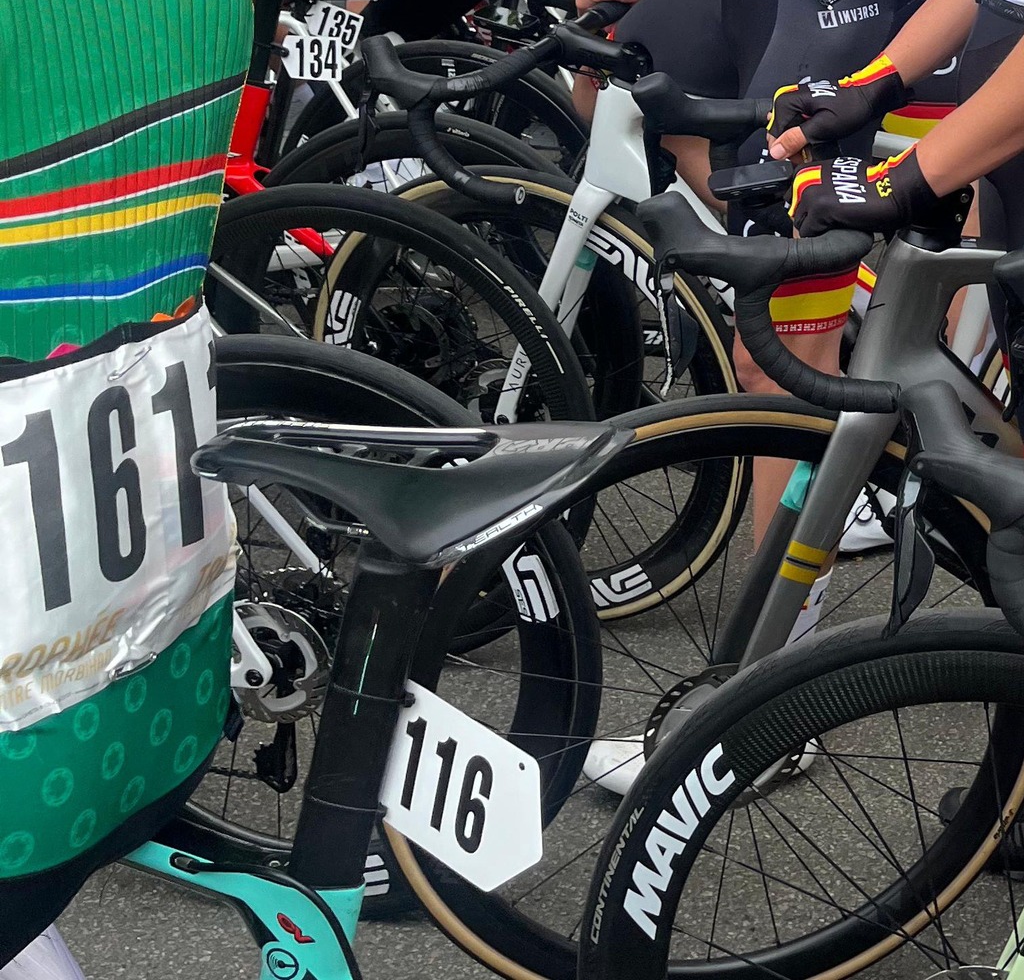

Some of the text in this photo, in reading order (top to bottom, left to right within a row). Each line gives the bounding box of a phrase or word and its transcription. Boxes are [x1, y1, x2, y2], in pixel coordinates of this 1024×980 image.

[295, 38, 338, 79] 134
[317, 5, 360, 47] 135
[839, 2, 880, 26] INVERSE
[503, 284, 549, 340] PIRELLI
[1, 360, 205, 613] 161
[400, 716, 494, 854] 116
[591, 806, 645, 945] CONTINENTAL
[623, 742, 736, 941] MAVIC
